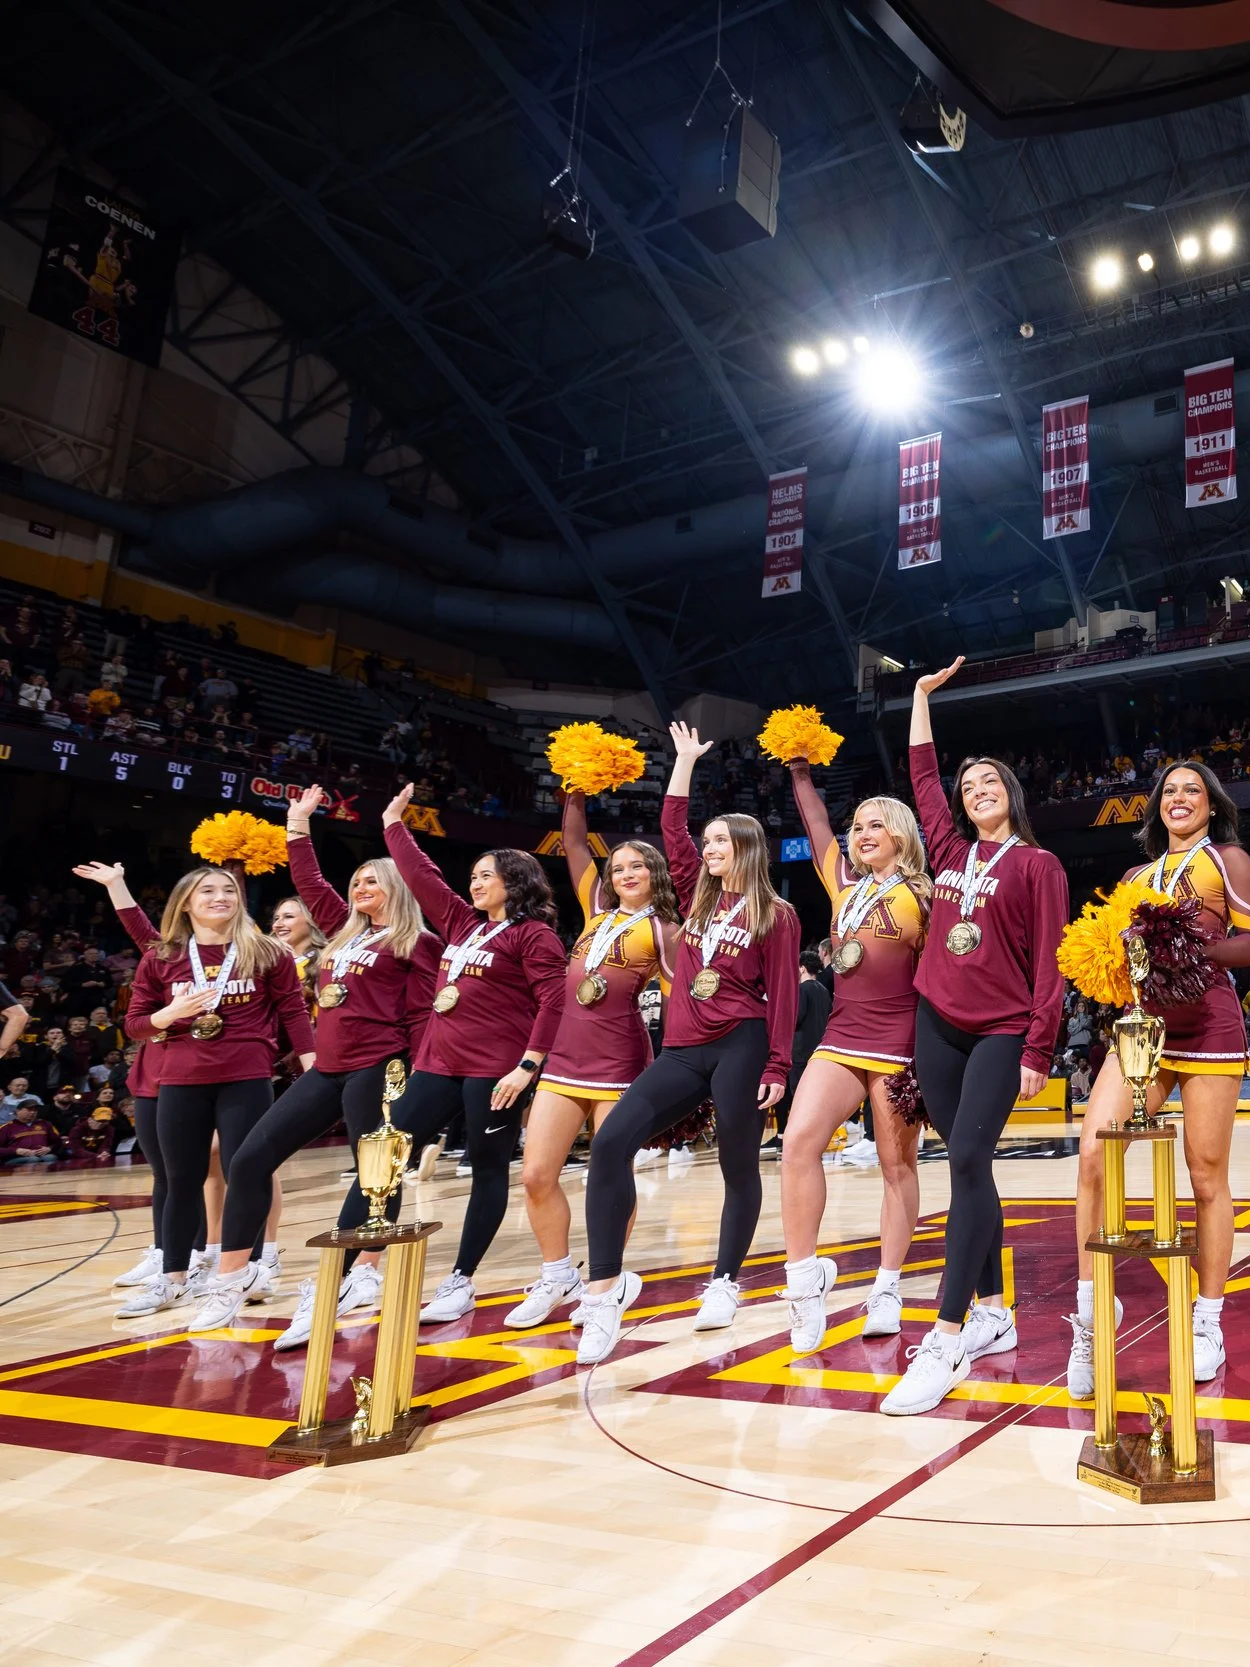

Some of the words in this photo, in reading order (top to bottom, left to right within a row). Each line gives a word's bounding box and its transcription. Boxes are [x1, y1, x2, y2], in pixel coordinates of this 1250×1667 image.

[85, 195, 156, 241] COENEN
[72, 306, 121, 347] 44
[1189, 394, 1207, 408] BIG
[1209, 388, 1232, 403] TEN
[1188, 400, 1233, 417] CHAMPIONS
[1046, 429, 1064, 443] BIG
[1066, 423, 1087, 438] TEN
[1046, 435, 1087, 452] CHAMPIONS
[1194, 434, 1225, 452] 1911
[903, 465, 919, 478] BIG
[921, 460, 939, 475] TEN
[1052, 468, 1081, 485] 1907
[1195, 465, 1228, 476] BASKETBALL
[902, 471, 939, 487] CHAMPIONS
[772, 483, 803, 498] HELMS
[906, 503, 934, 519] 1906
[768, 513, 803, 527] CHAMPIONS
[771, 534, 797, 549] 1902
[53, 740, 79, 755] STL
[110, 752, 138, 765] AST
[168, 762, 192, 775] BLK
[220, 771, 236, 784] TO
[60, 756, 68, 771] 1
[115, 767, 128, 781] 5
[172, 776, 184, 790] 0
[221, 785, 233, 798] 3
[251, 777, 284, 799] Old
[718, 942, 740, 958] EAM
